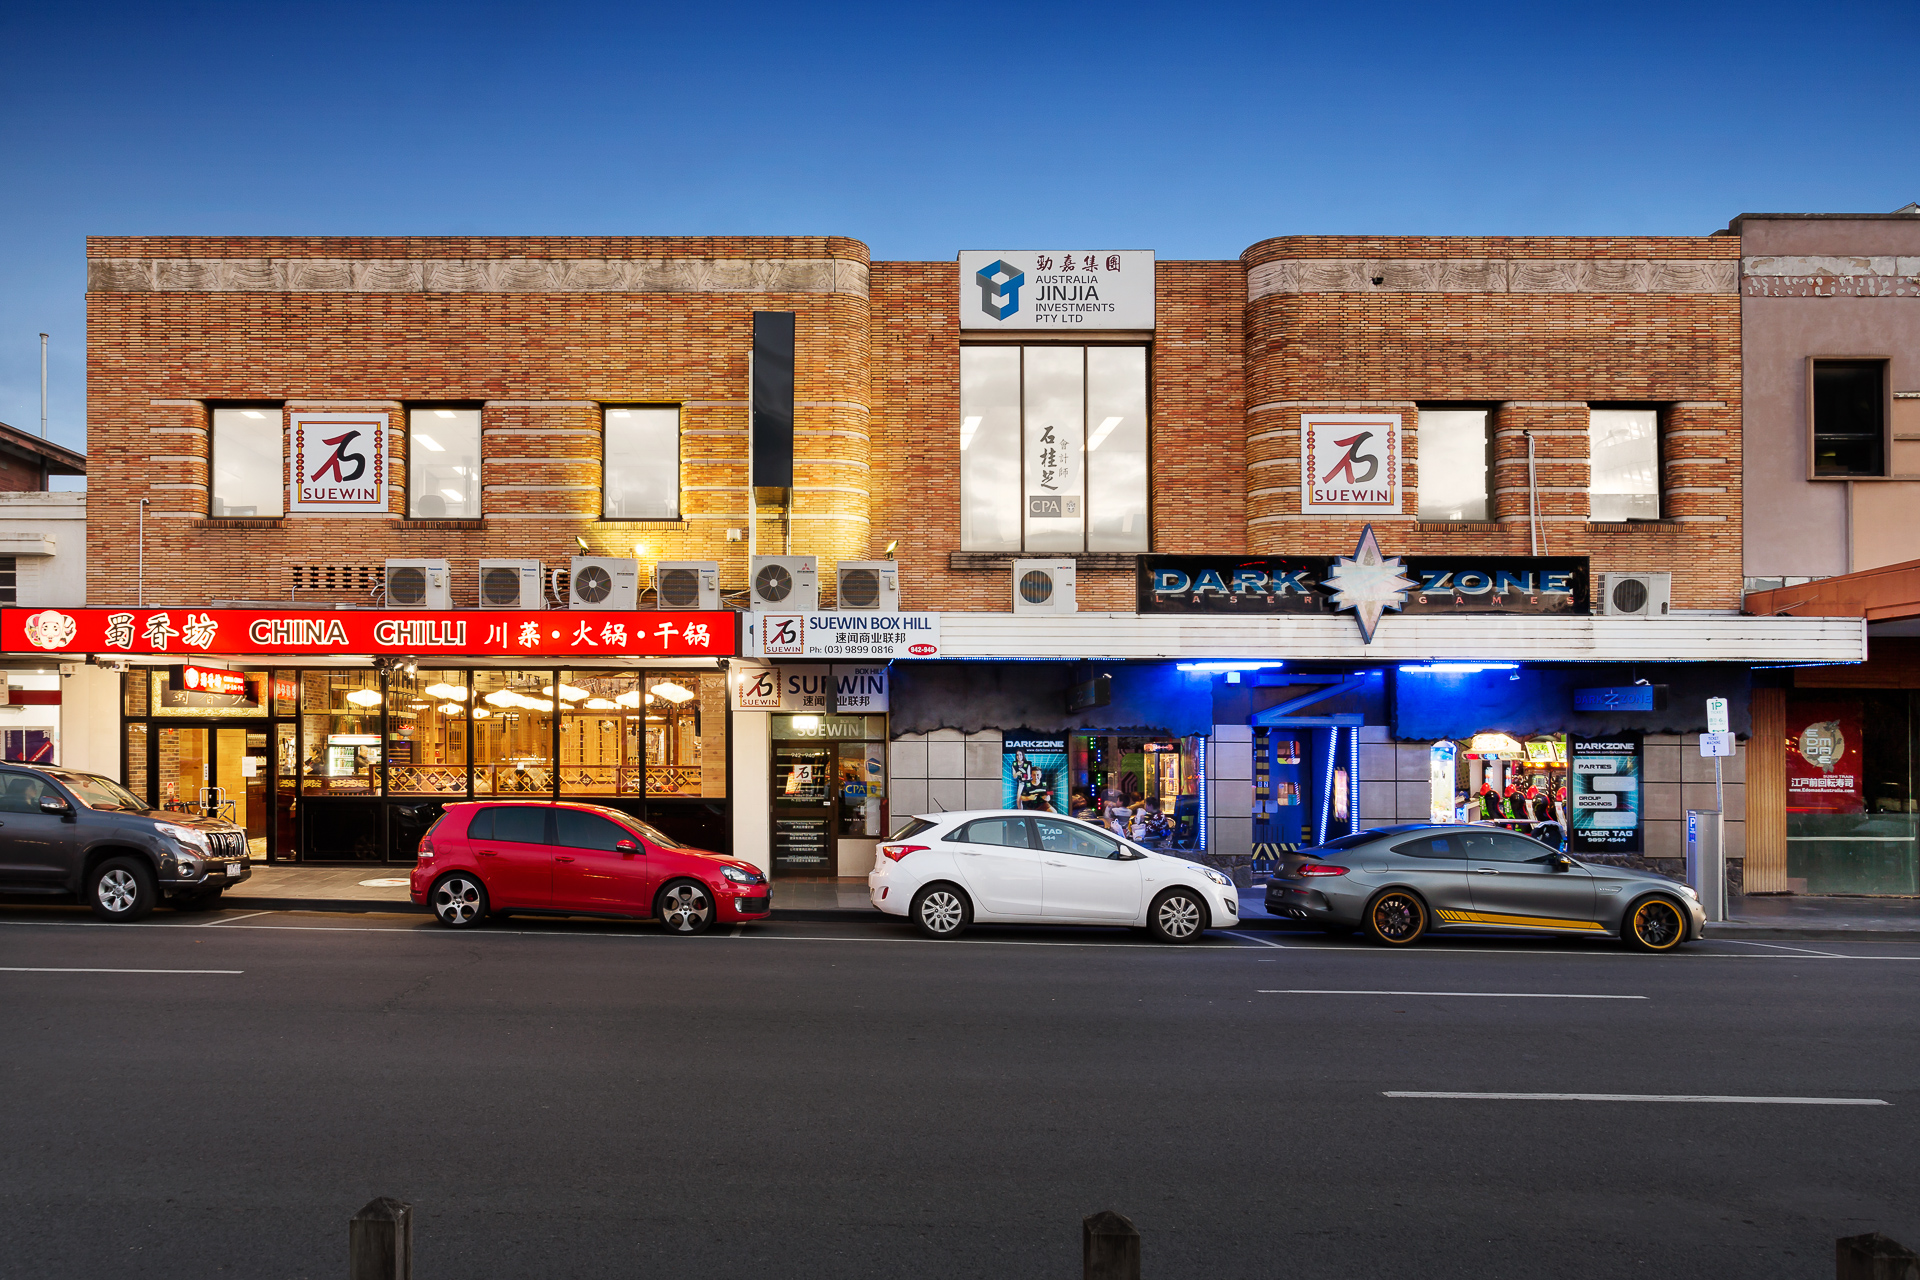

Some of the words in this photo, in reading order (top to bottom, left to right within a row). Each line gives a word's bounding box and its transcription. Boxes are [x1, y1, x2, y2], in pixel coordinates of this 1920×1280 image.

[1036, 254, 1121, 273] 勁嘉集團
[1036, 275, 1098, 284] AUSTRALIA
[1036, 285, 1100, 301] JINJIA
[1036, 303, 1115, 312] INVESTMENTS
[1036, 314, 1058, 323] PTY
[1062, 314, 1083, 323] LTD
[303, 488, 374, 499] SUEWIN
[1314, 490, 1388, 501] SUEWIN
[1031, 500, 1060, 513] CPA
[1151, 569, 1312, 595] DARK
[1418, 569, 1574, 596] ZONE
[1156, 596, 1313, 604] LASER
[1418, 596, 1575, 604] GAMES
[810, 616, 866, 630] SUEWIN
[870, 617, 900, 630] BOX
[903, 617, 931, 630] HILL
[105, 613, 218, 650] 蜀香坊
[249, 619, 349, 645] CHINA
[373, 620, 467, 646] CHILLI
[835, 632, 906, 644] 速闻商业联邦
[824, 645, 842, 654] (03)
[845, 646, 869, 654] 9899
[871, 646, 894, 654] 0816
[803, 696, 870, 707] 速闻业联邦
[1620, 694, 1651, 704] ZONE
[1711, 701, 1723, 710] 1P
[845, 785, 866, 794] CPA
[1690, 817, 1696, 827] P
